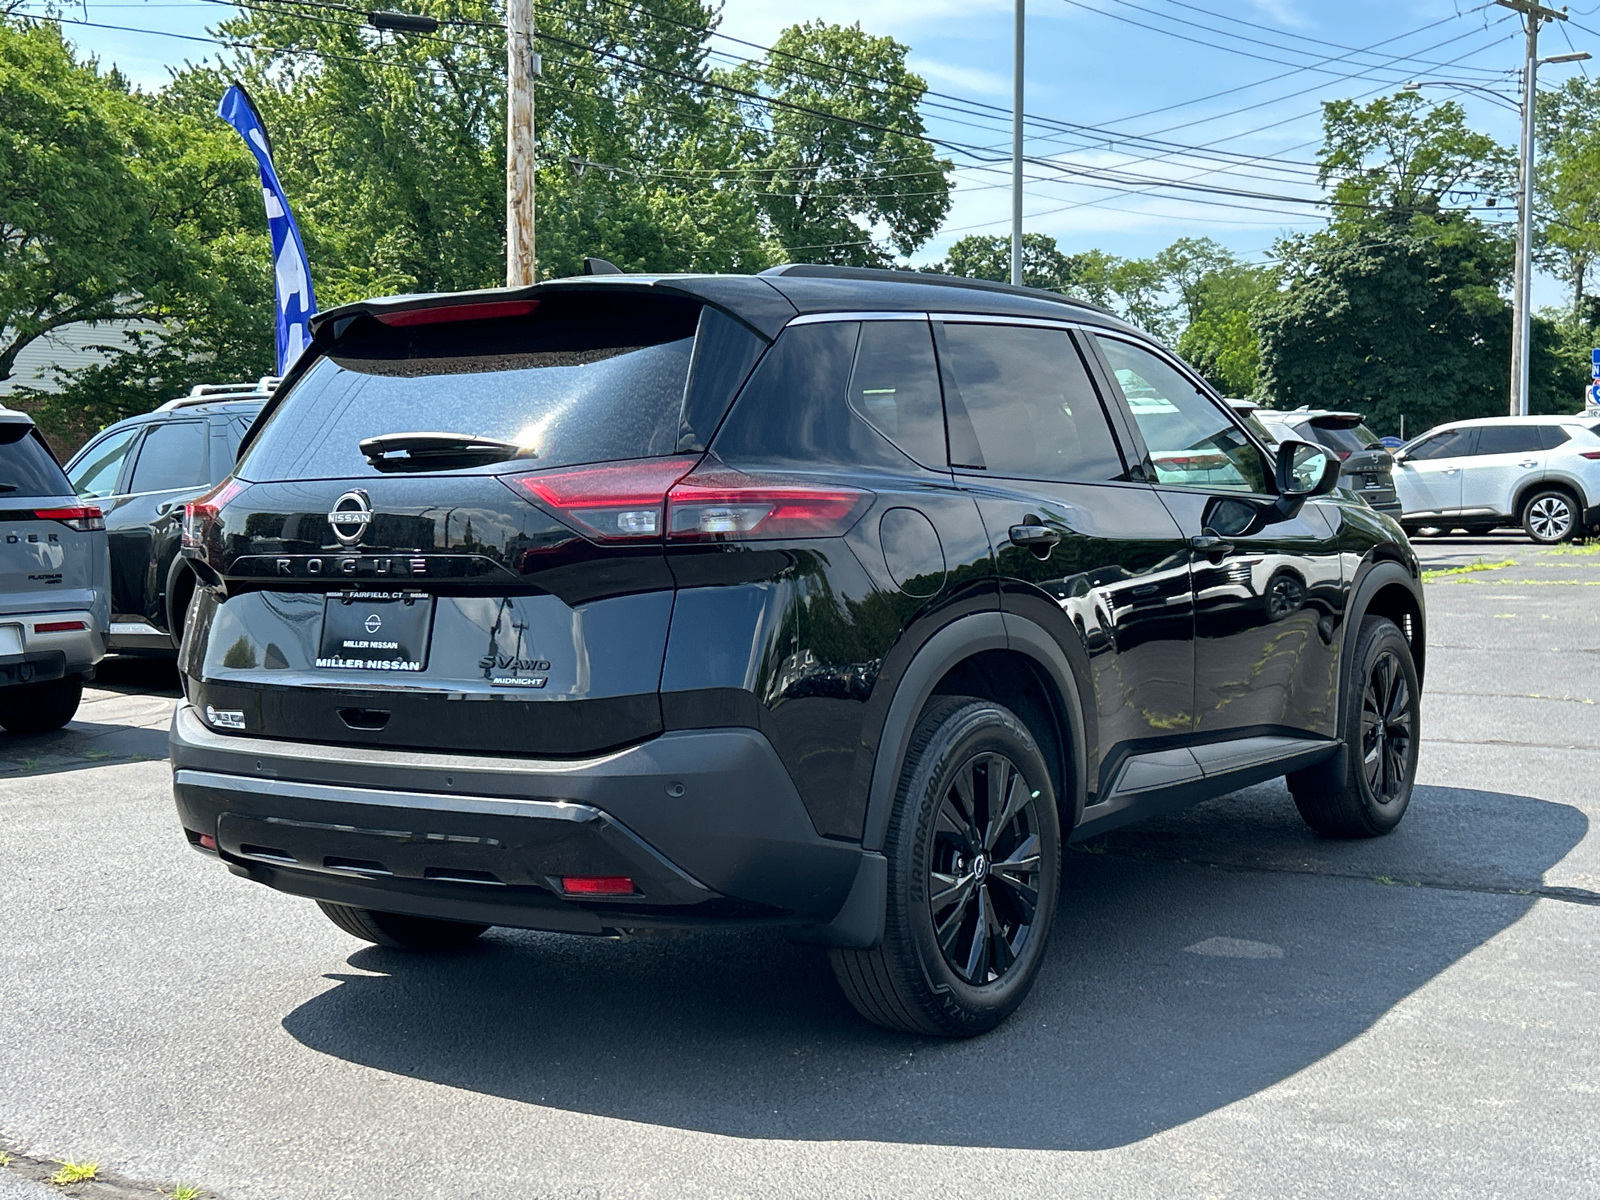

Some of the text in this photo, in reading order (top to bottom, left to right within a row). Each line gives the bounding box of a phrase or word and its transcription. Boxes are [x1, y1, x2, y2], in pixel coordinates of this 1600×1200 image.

[328, 514, 371, 523] NISSAN
[276, 558, 427, 575] ROGUE
[343, 640, 398, 650] MILLER NISSAN
[315, 658, 420, 671] MILLER NISSAN
[493, 677, 543, 685] MIDNIGHT
[909, 752, 949, 903] BRIDGESTONE
